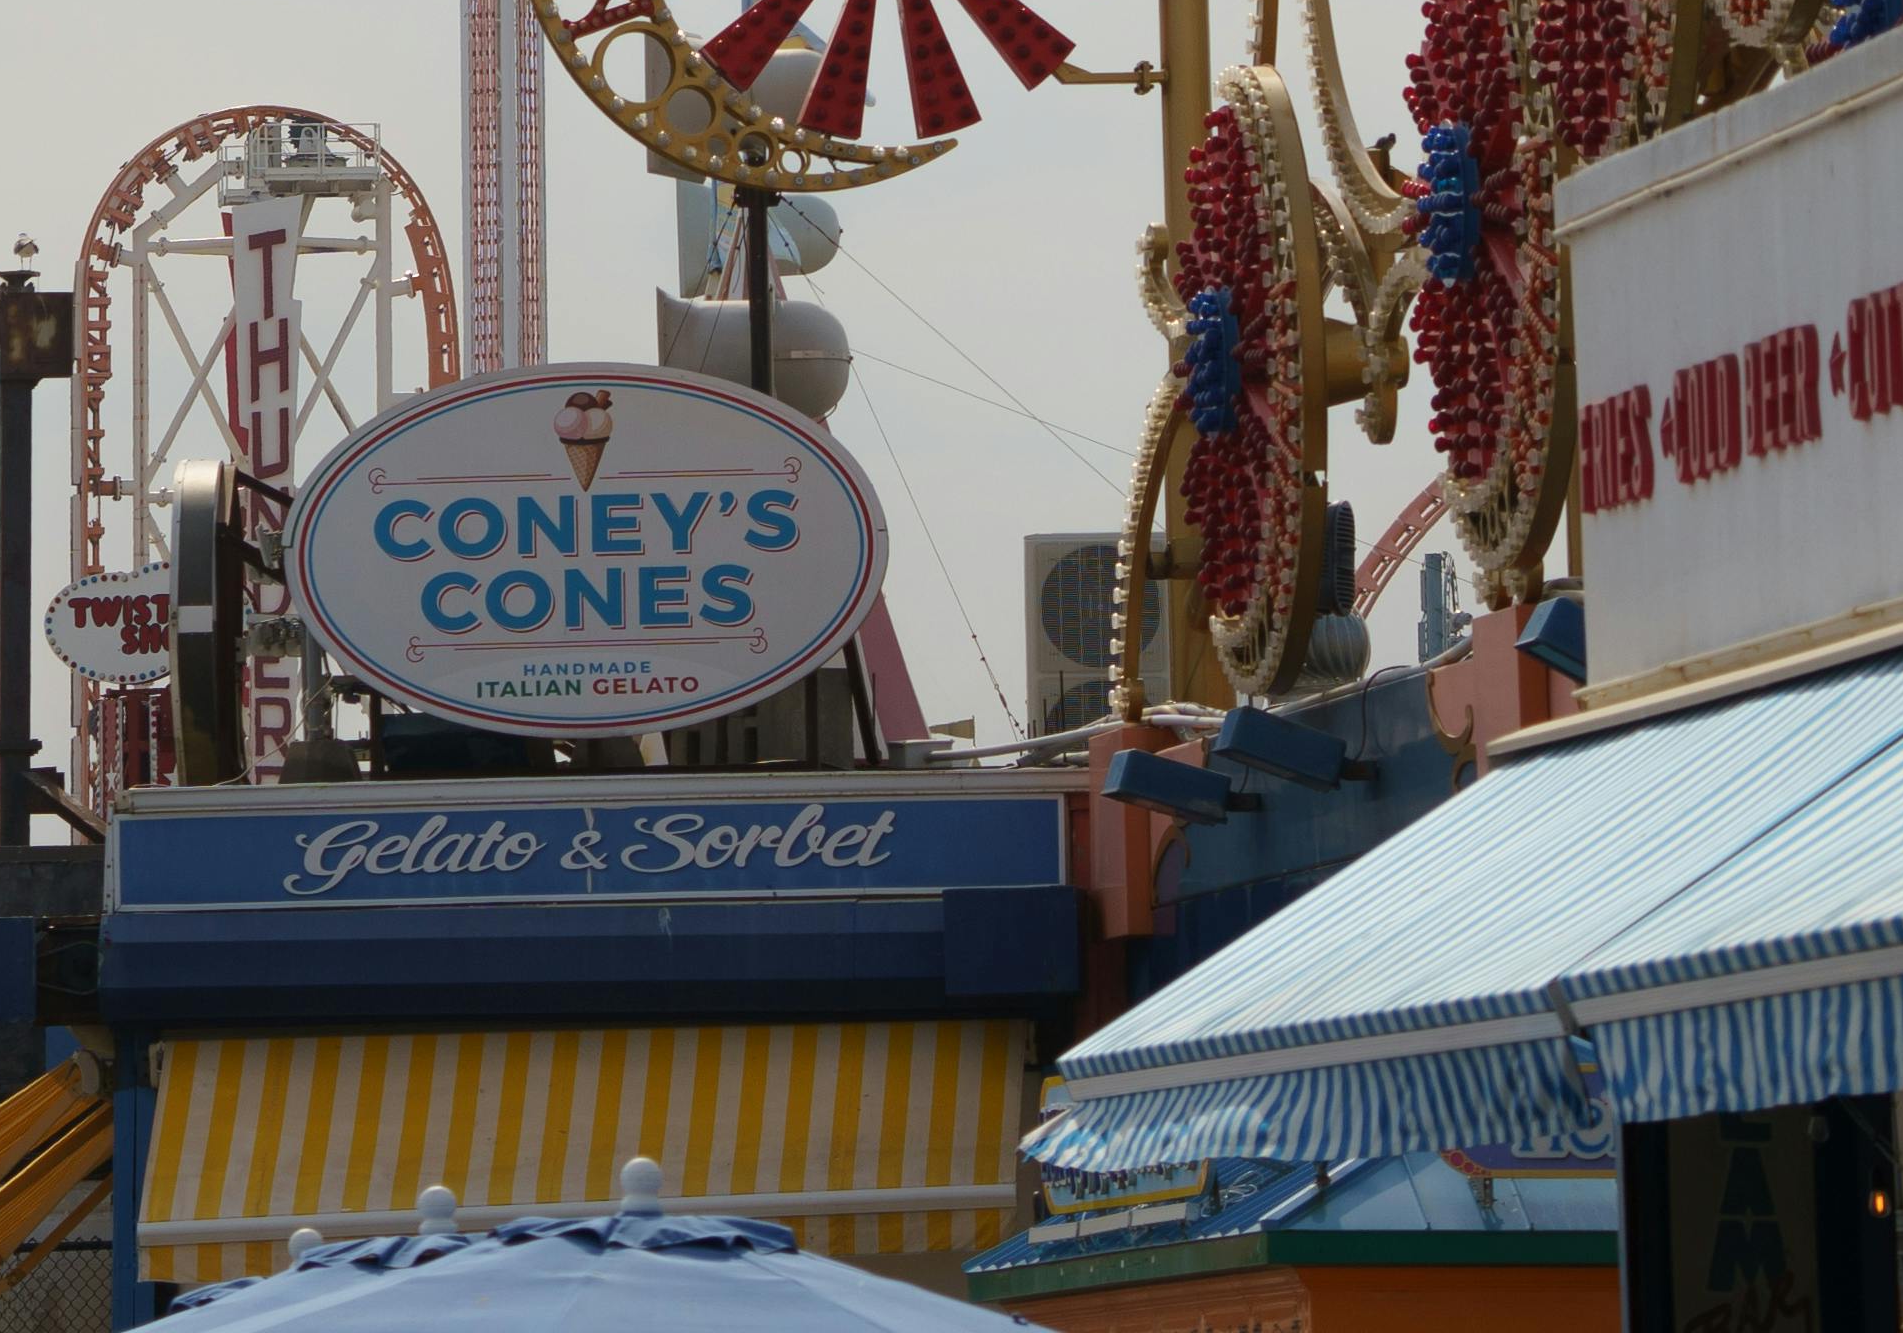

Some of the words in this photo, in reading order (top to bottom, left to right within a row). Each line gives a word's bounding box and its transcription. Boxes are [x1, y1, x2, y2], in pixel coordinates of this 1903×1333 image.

[1578, 384, 1656, 515] FRIES
[1673, 353, 1742, 486] COLD
[1743, 324, 1823, 458] BEER
[373, 488, 801, 561] CONEY'S
[419, 563, 757, 634] CONES
[476, 678, 584, 699] ITALIAN
[591, 675, 701, 696] GELATO
[522, 660, 653, 677] HANDMADE
[282, 814, 547, 896] Gelato
[559, 829, 608, 871] &
[620, 802, 897, 874] Sorbet
